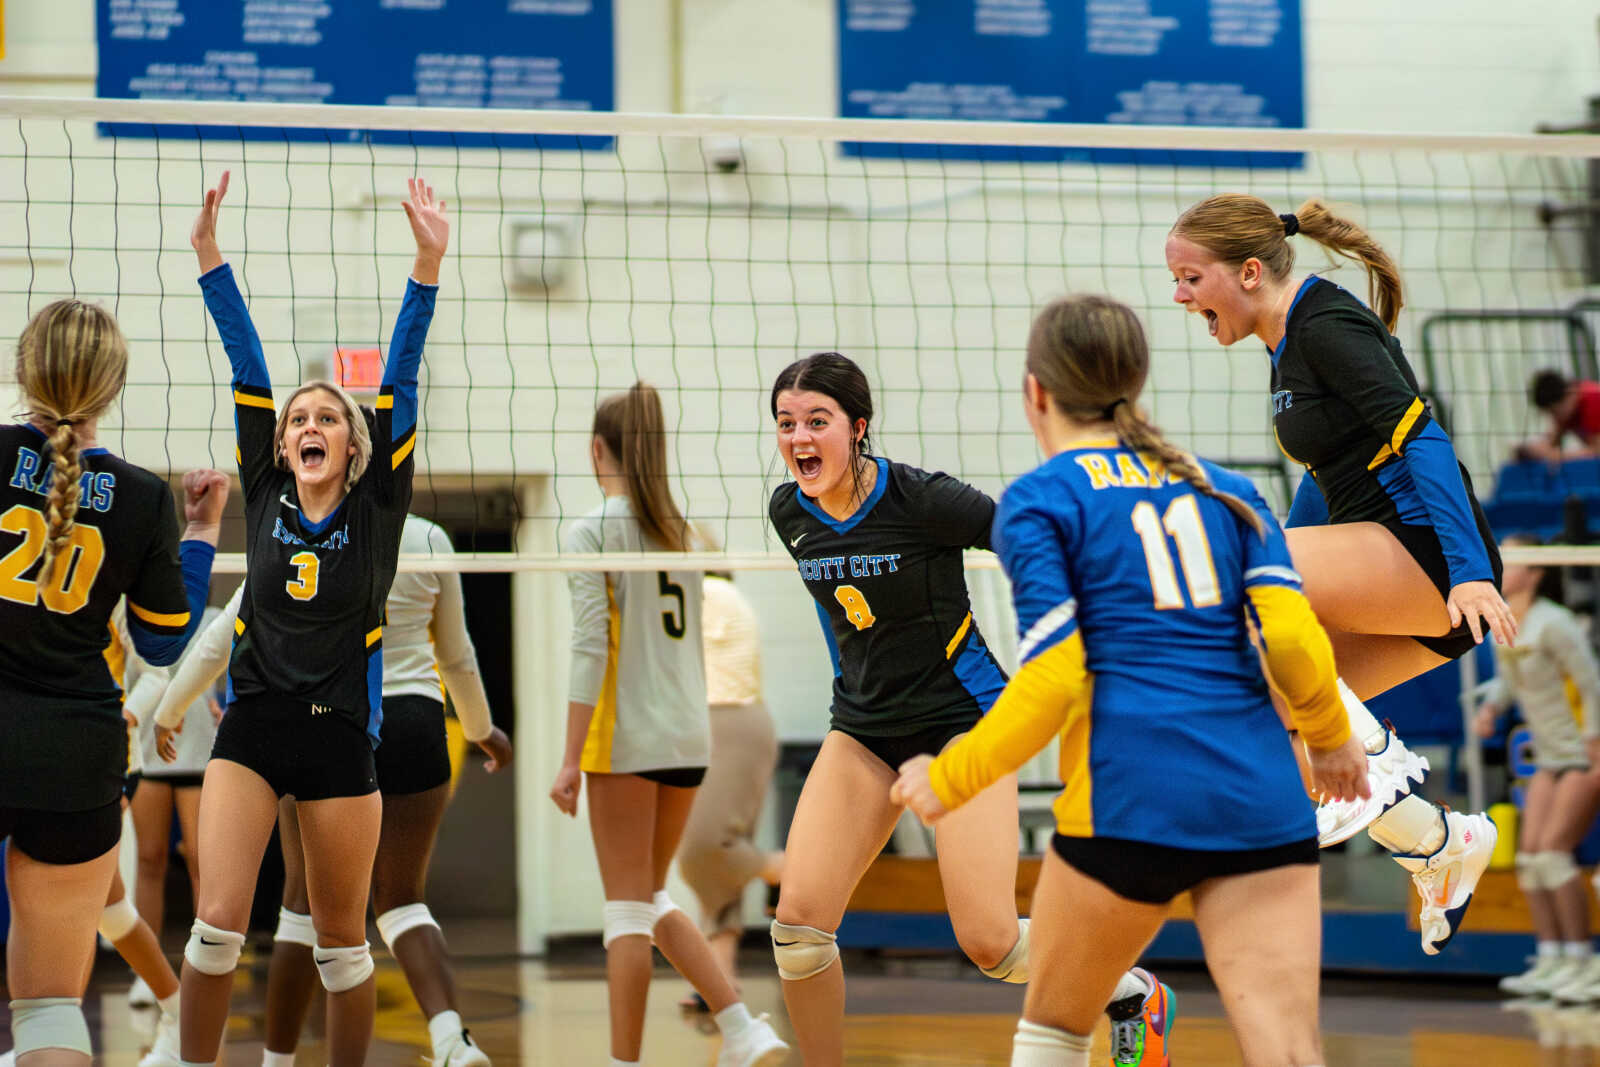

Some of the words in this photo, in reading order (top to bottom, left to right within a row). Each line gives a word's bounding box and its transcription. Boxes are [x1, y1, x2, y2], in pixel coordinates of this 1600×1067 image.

[1074, 452, 1207, 490] RAM
[0, 503, 105, 615] 20
[286, 551, 320, 601] 3
[798, 556, 845, 581] SCOTT
[849, 553, 901, 578] CITY
[1131, 493, 1222, 610] 11
[657, 570, 686, 640] 5
